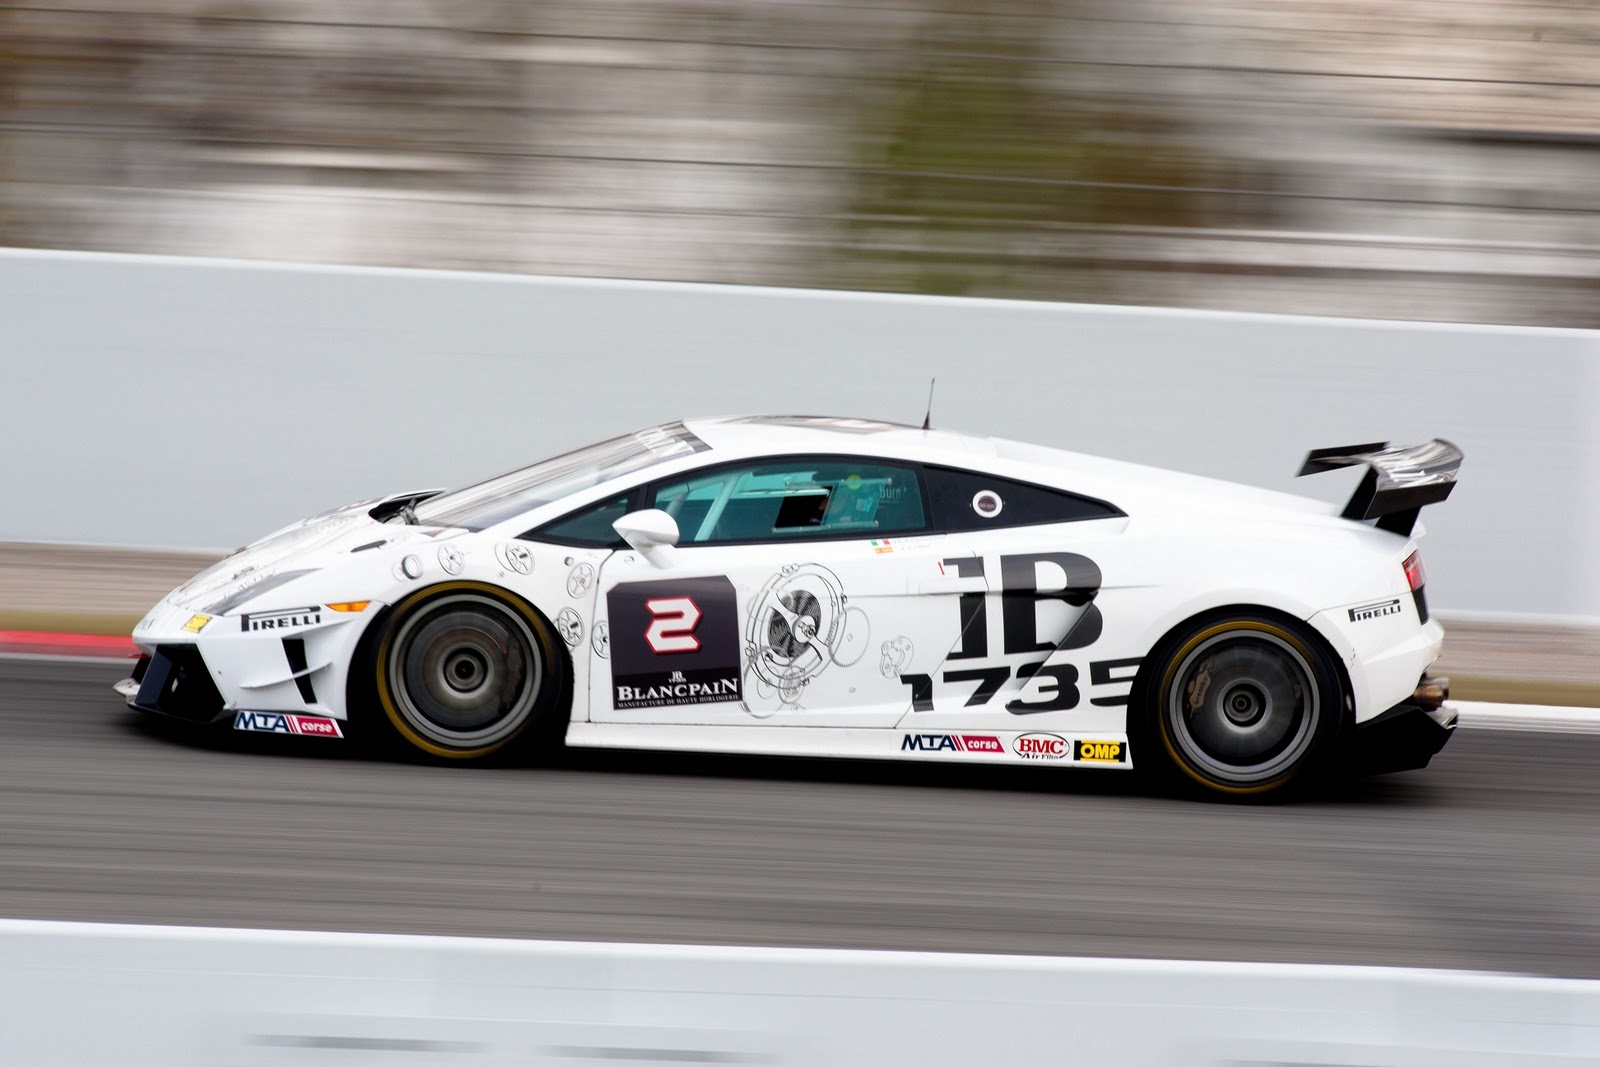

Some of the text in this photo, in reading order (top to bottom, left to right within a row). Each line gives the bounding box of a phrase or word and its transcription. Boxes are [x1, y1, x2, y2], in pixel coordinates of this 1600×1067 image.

[241, 606, 322, 632] PIRELLI
[1347, 598, 1402, 623] PIRELLI
[644, 595, 702, 655] 2
[616, 678, 739, 701] BLANCPAIN
[899, 655, 1148, 716] 1735
[617, 693, 739, 708] MANUFACTURE DE HAUTE HORLOGERIE
[235, 712, 333, 733] MTA corse
[901, 734, 999, 751] MTA corse
[1018, 738, 1064, 754] BMC
[1080, 743, 1120, 760] OMP
[1021, 752, 1041, 760] Air
